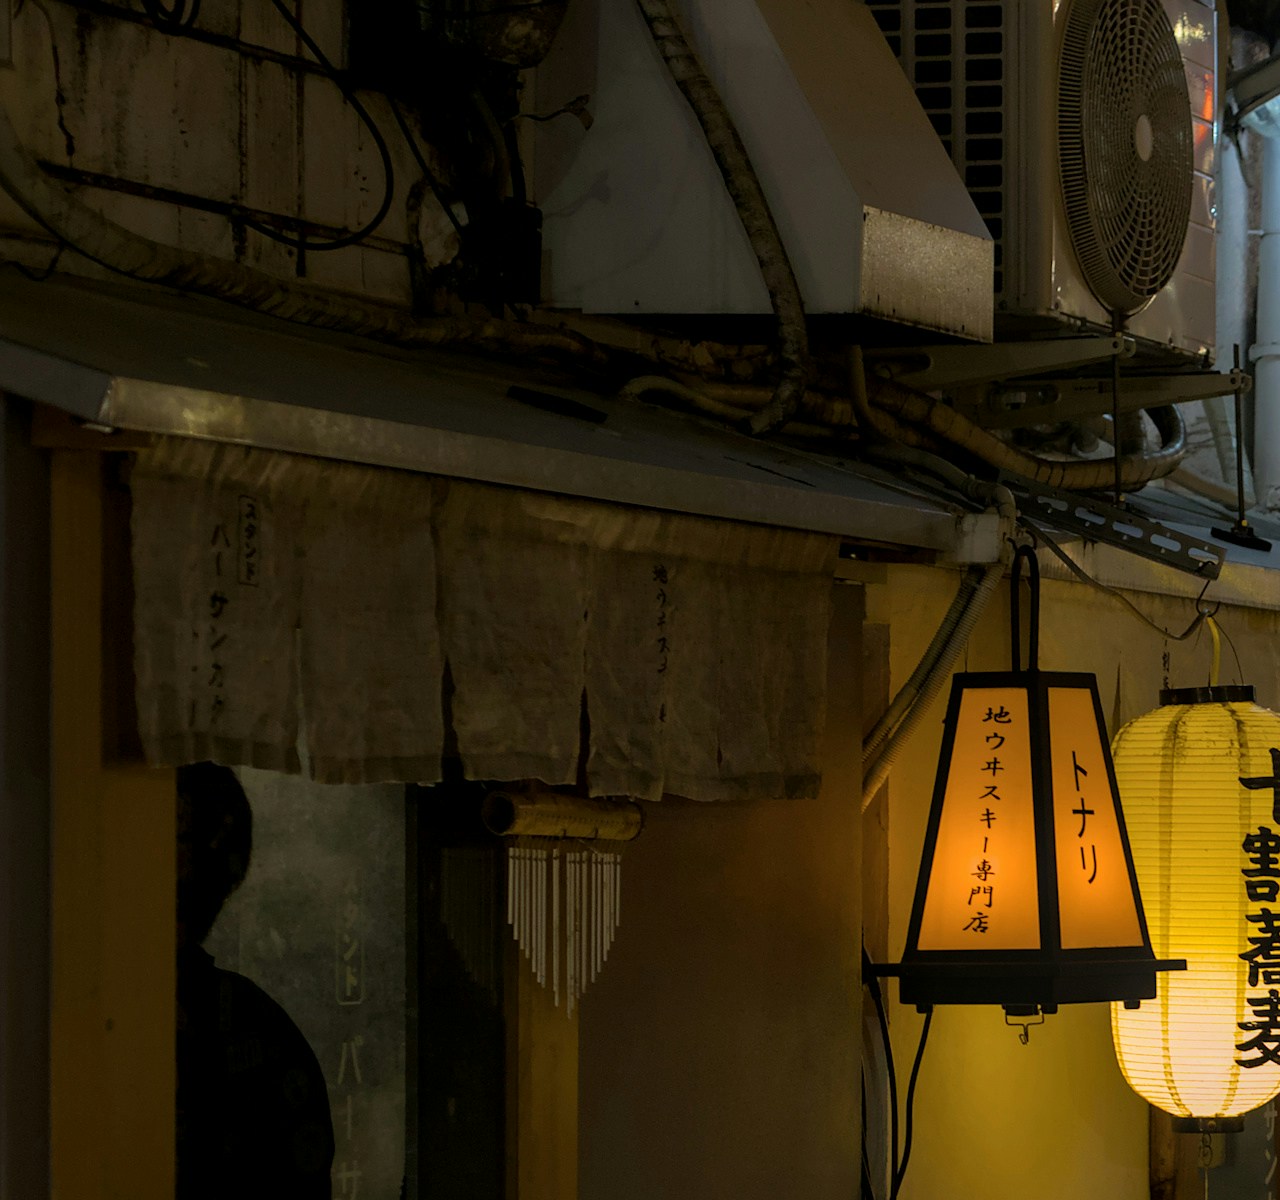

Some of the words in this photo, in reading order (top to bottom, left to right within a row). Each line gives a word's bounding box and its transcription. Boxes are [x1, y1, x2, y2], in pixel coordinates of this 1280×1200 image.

[961, 705, 1012, 934] 地ウヰスキー専門店
[1071, 750, 1097, 885] トナリ
